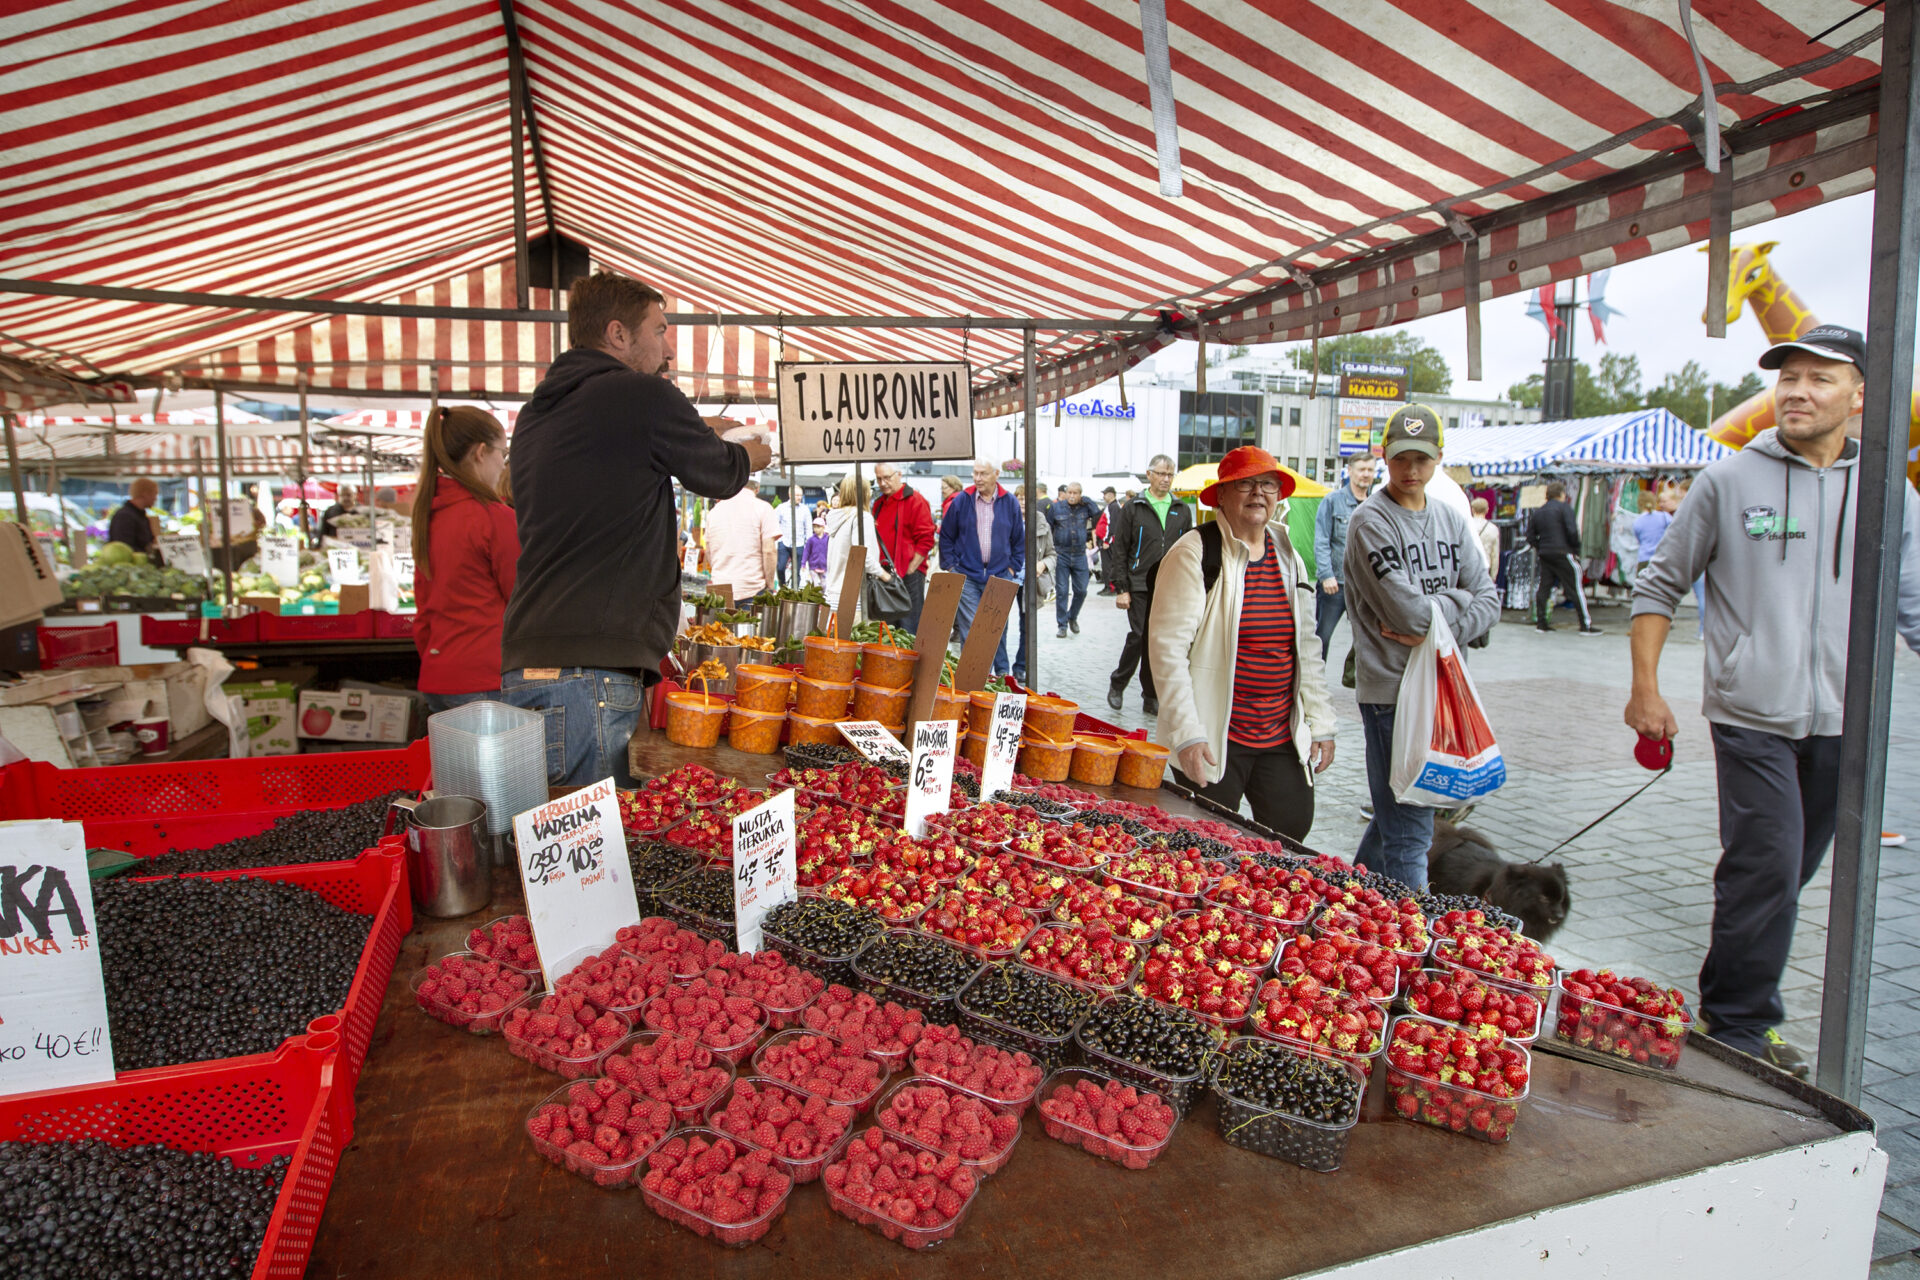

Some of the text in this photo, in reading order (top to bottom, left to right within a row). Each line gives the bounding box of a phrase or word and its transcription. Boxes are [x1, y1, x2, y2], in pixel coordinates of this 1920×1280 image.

[793, 371, 959, 423] T.LAURONEN
[1349, 384, 1398, 398] HARALD
[823, 427, 936, 454] 0440 577 425
[1368, 545, 1402, 580] 29
[1420, 576, 1449, 595] 1929
[532, 804, 602, 841] VADELMA
[737, 819, 784, 851] HERUKKA
[0, 864, 87, 940] KA
